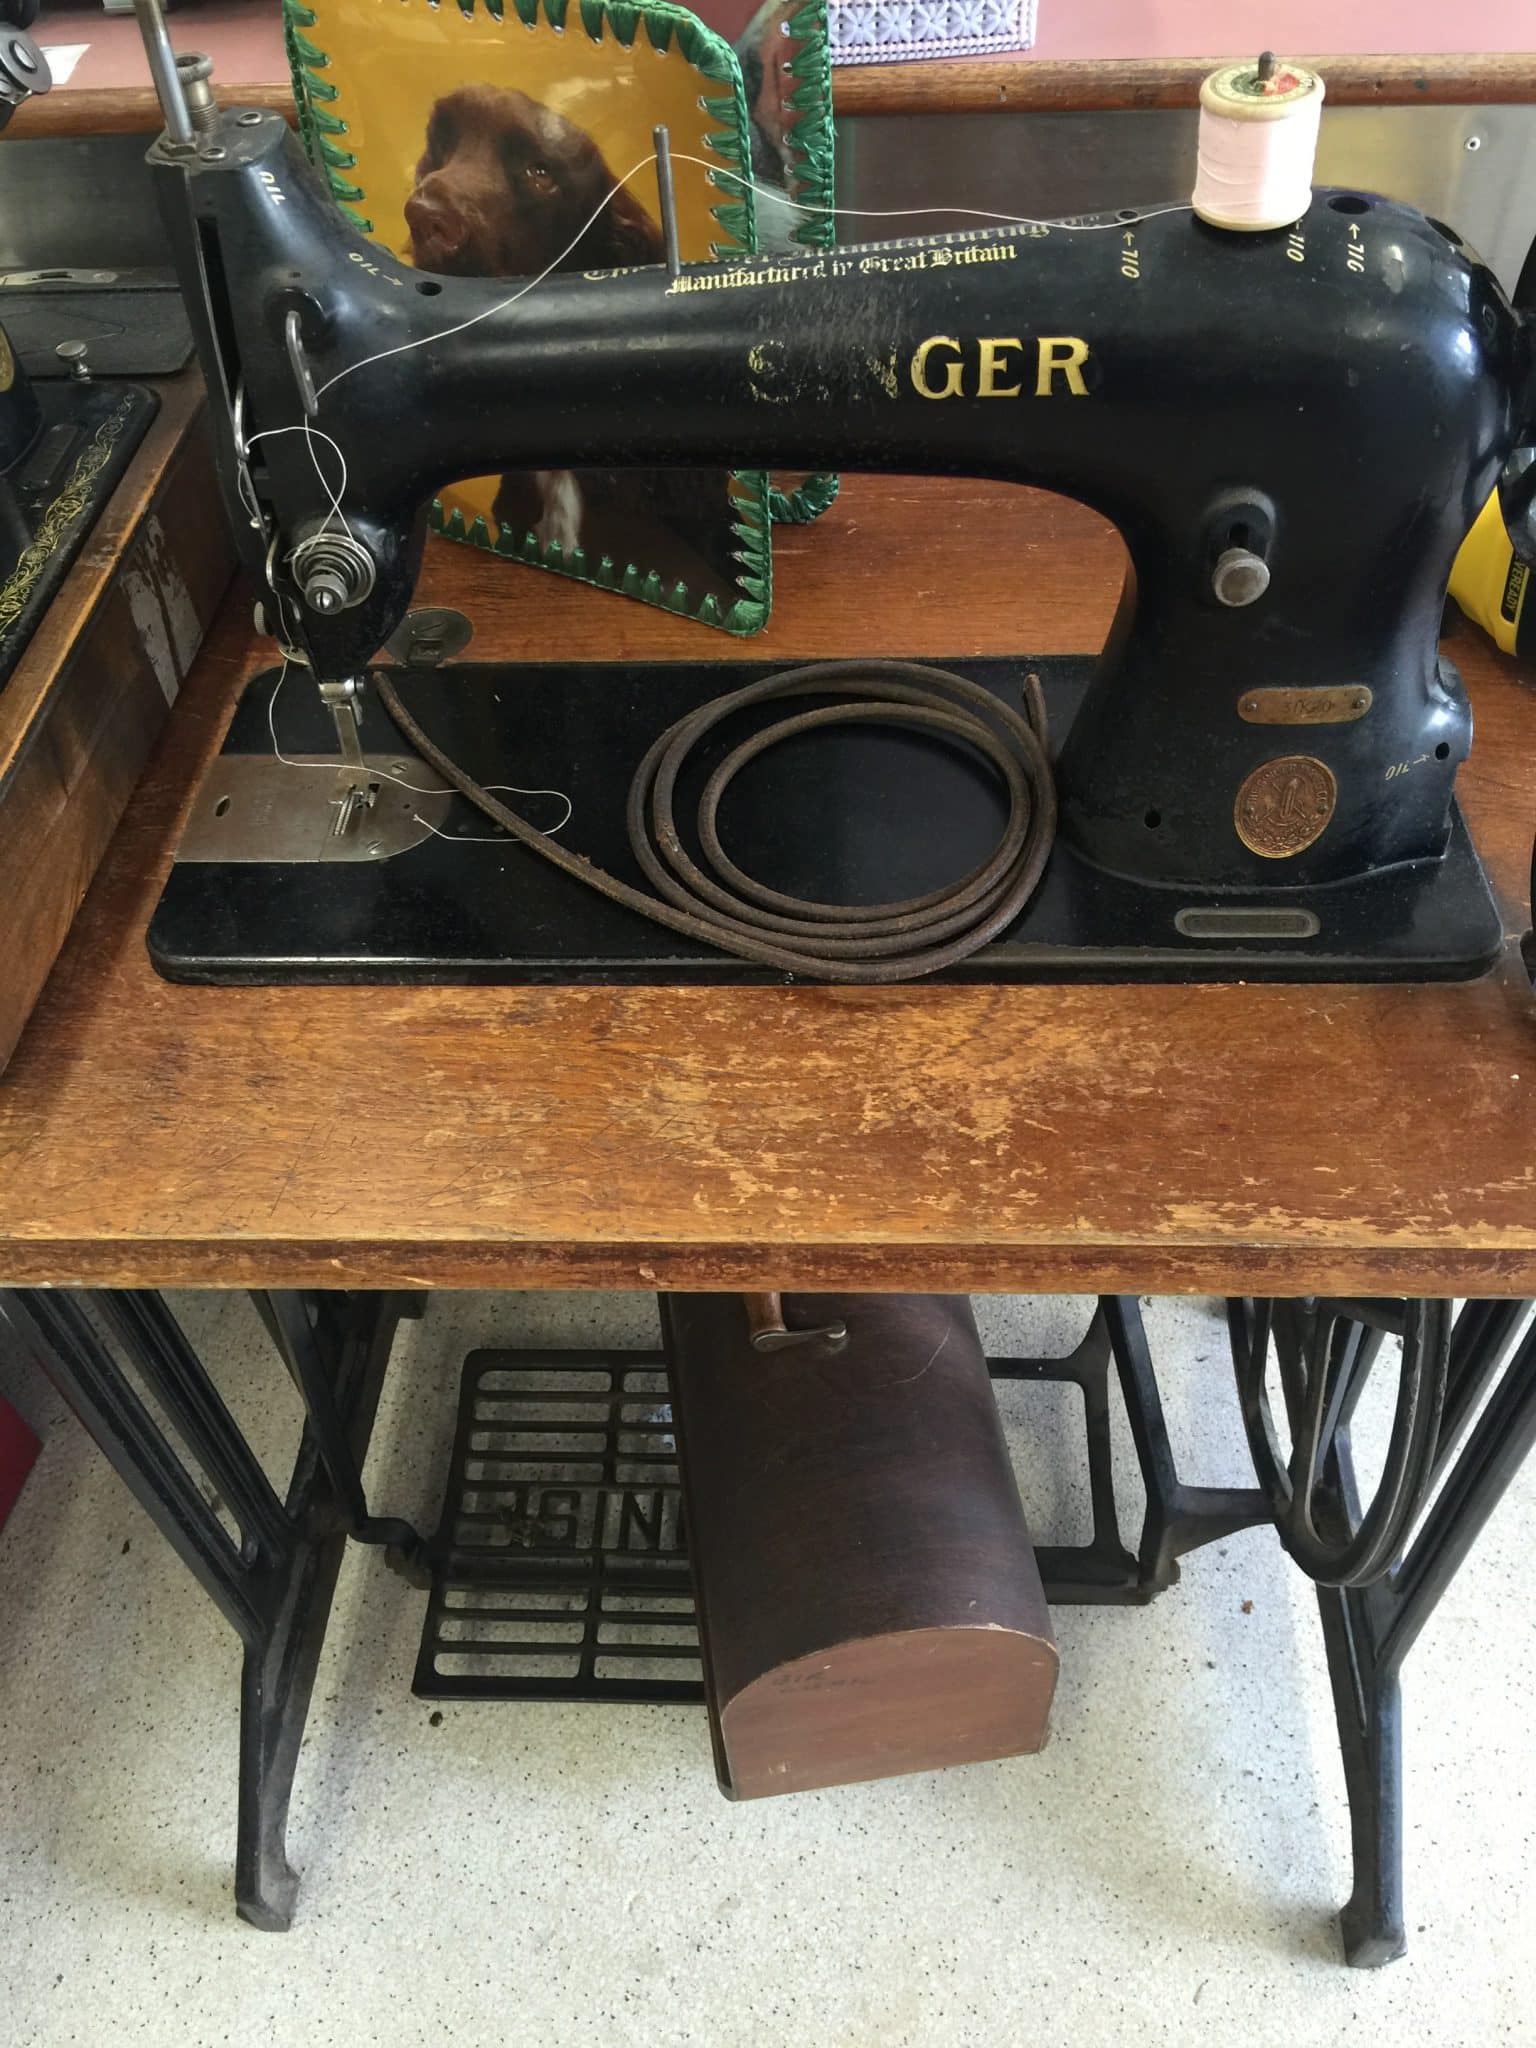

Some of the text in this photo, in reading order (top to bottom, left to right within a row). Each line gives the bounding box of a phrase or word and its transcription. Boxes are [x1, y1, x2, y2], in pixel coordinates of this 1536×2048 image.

[258, 171, 287, 206] OIL
[1287, 232, 1305, 263] OIL
[1346, 242, 1365, 273] OIL
[349, 252, 381, 276] OIL
[665, 260, 827, 297] Manufactured
[858, 250, 928, 275] Great
[929, 242, 1018, 267] Britain
[1121, 249, 1140, 279] OIL
[1505, 554, 1527, 613] VEREADY
[1385, 763, 1410, 781] OIL
